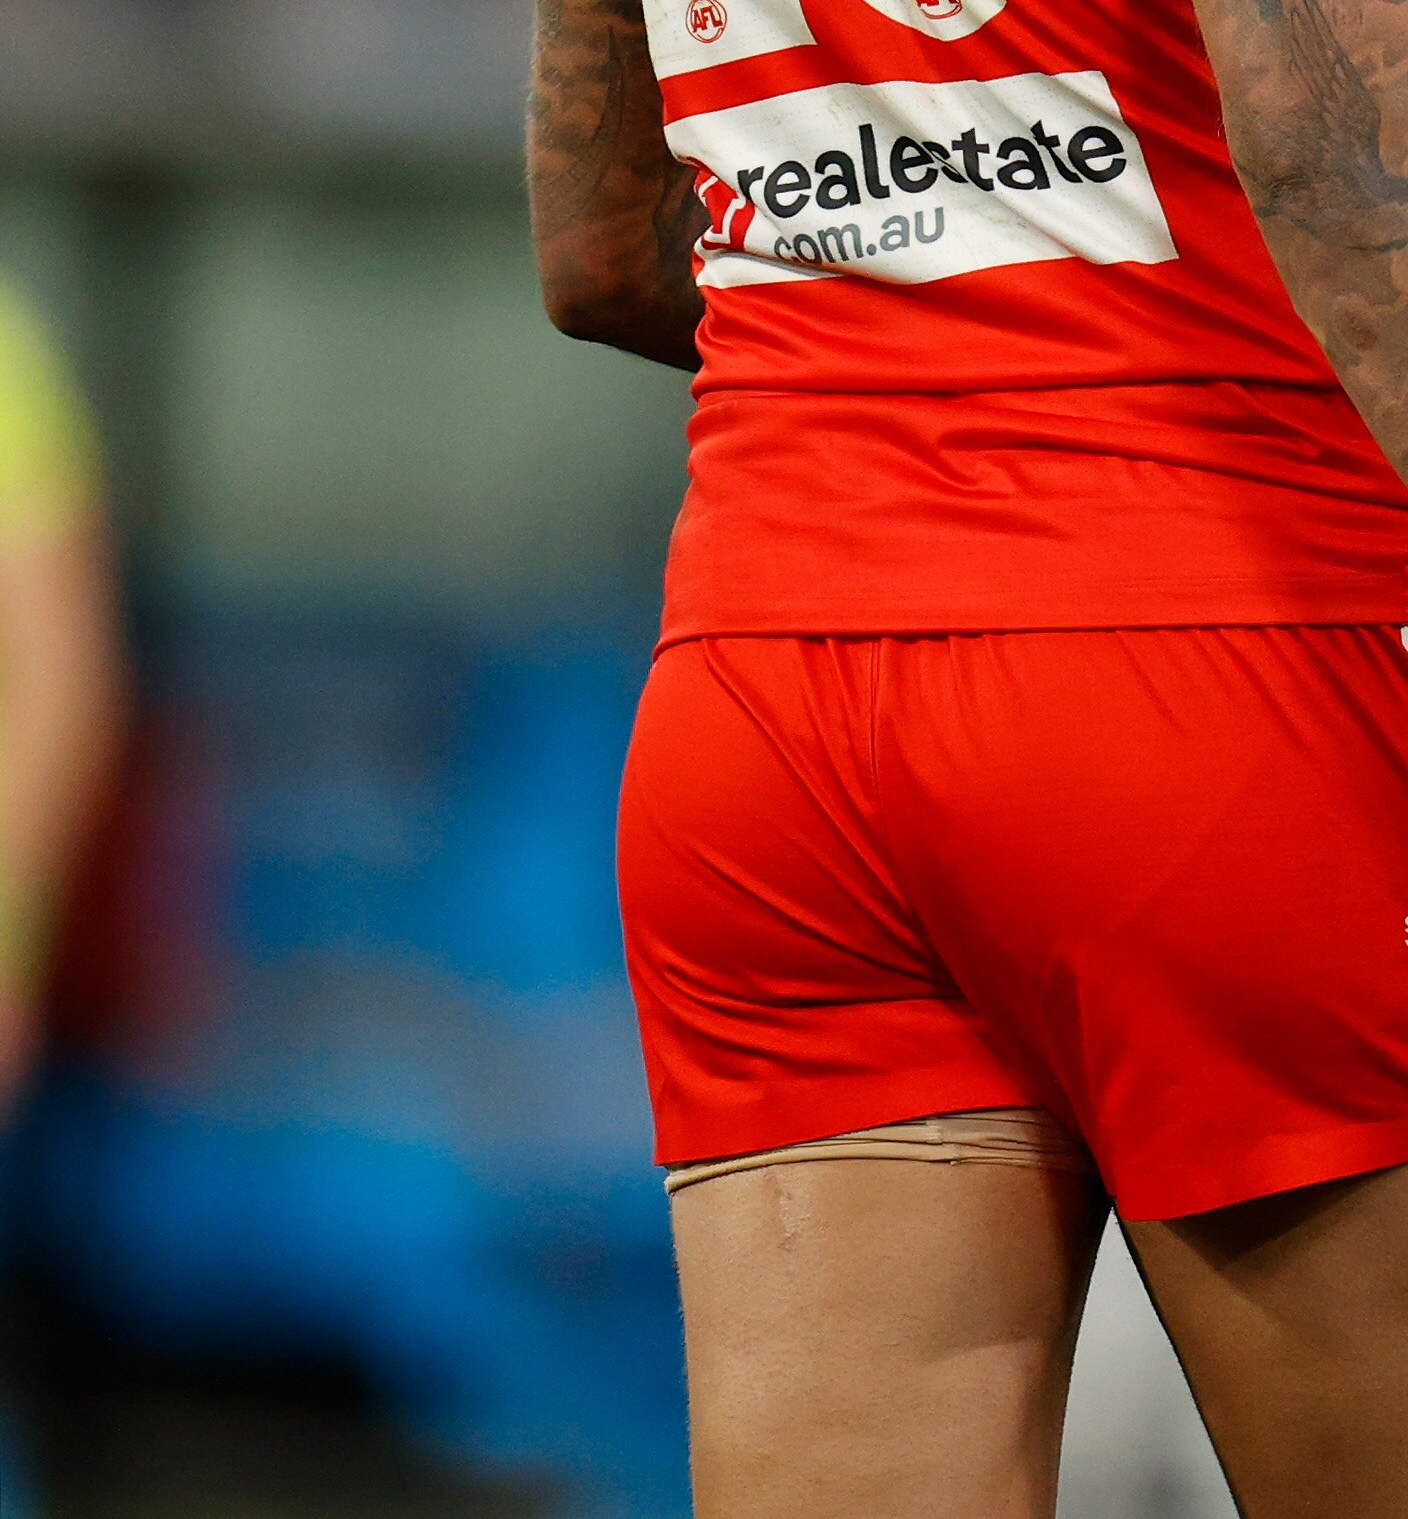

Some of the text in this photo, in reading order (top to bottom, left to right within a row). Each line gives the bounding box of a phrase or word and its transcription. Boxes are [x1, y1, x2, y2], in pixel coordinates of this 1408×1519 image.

[691, 6, 724, 33] AFL
[736, 119, 1128, 219] realestate
[773, 205, 945, 265] com.au
